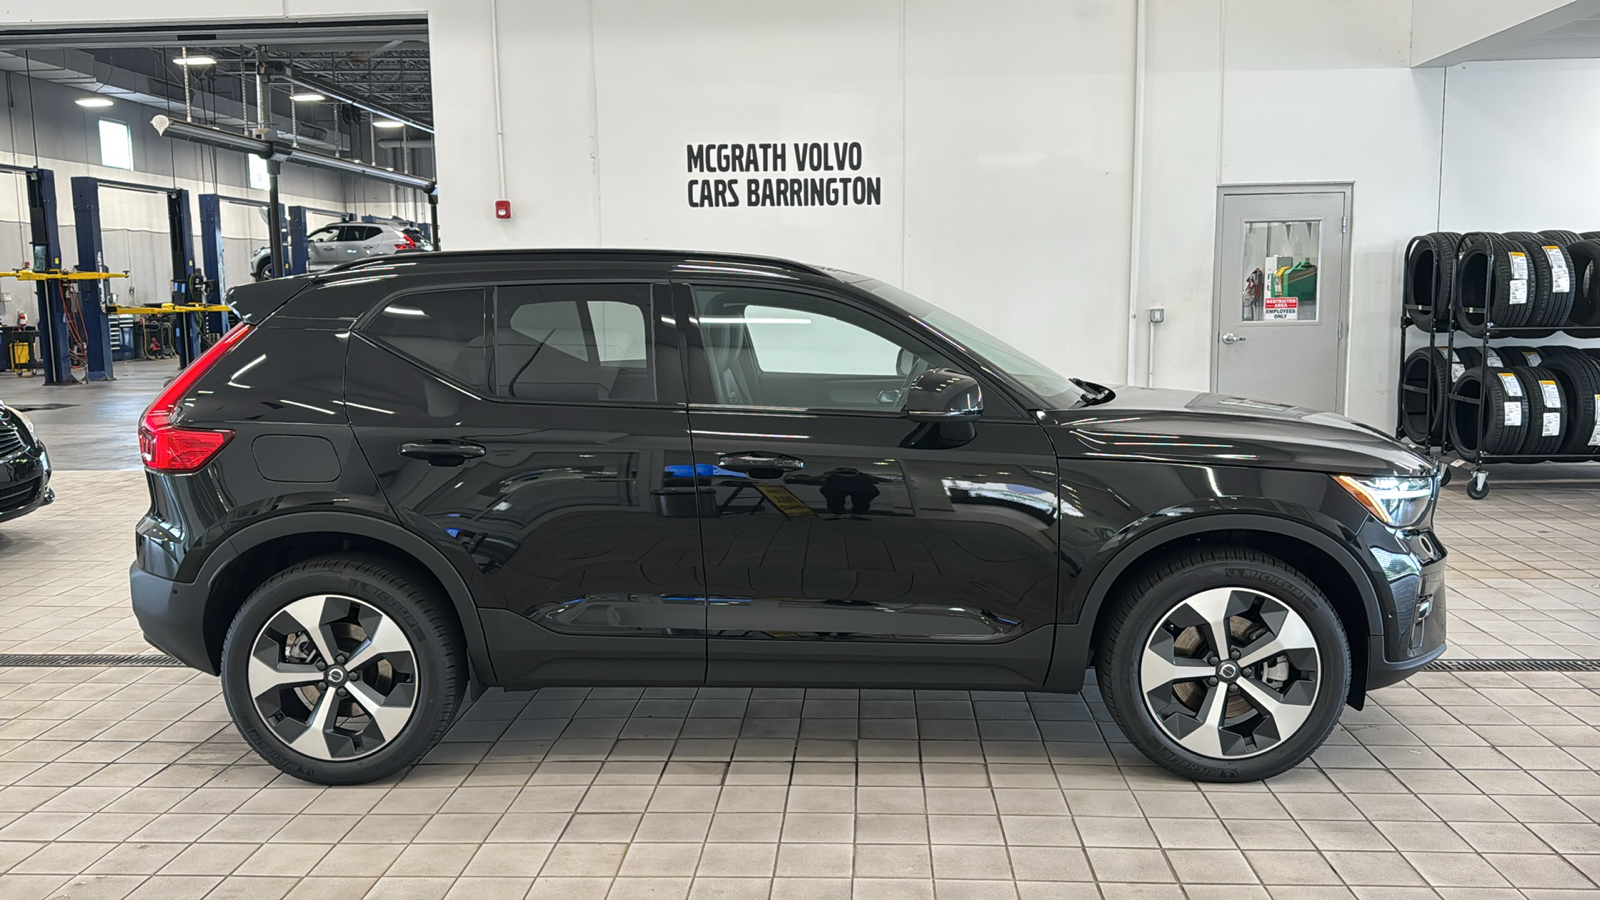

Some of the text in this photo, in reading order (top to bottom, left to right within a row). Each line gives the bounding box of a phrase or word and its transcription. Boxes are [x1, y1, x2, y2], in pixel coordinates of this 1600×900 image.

[687, 142, 862, 173] MCGRATH VOLVO
[687, 176, 881, 207] CARS BARRINGTON
[1242, 568, 1306, 600] MICHELIN
